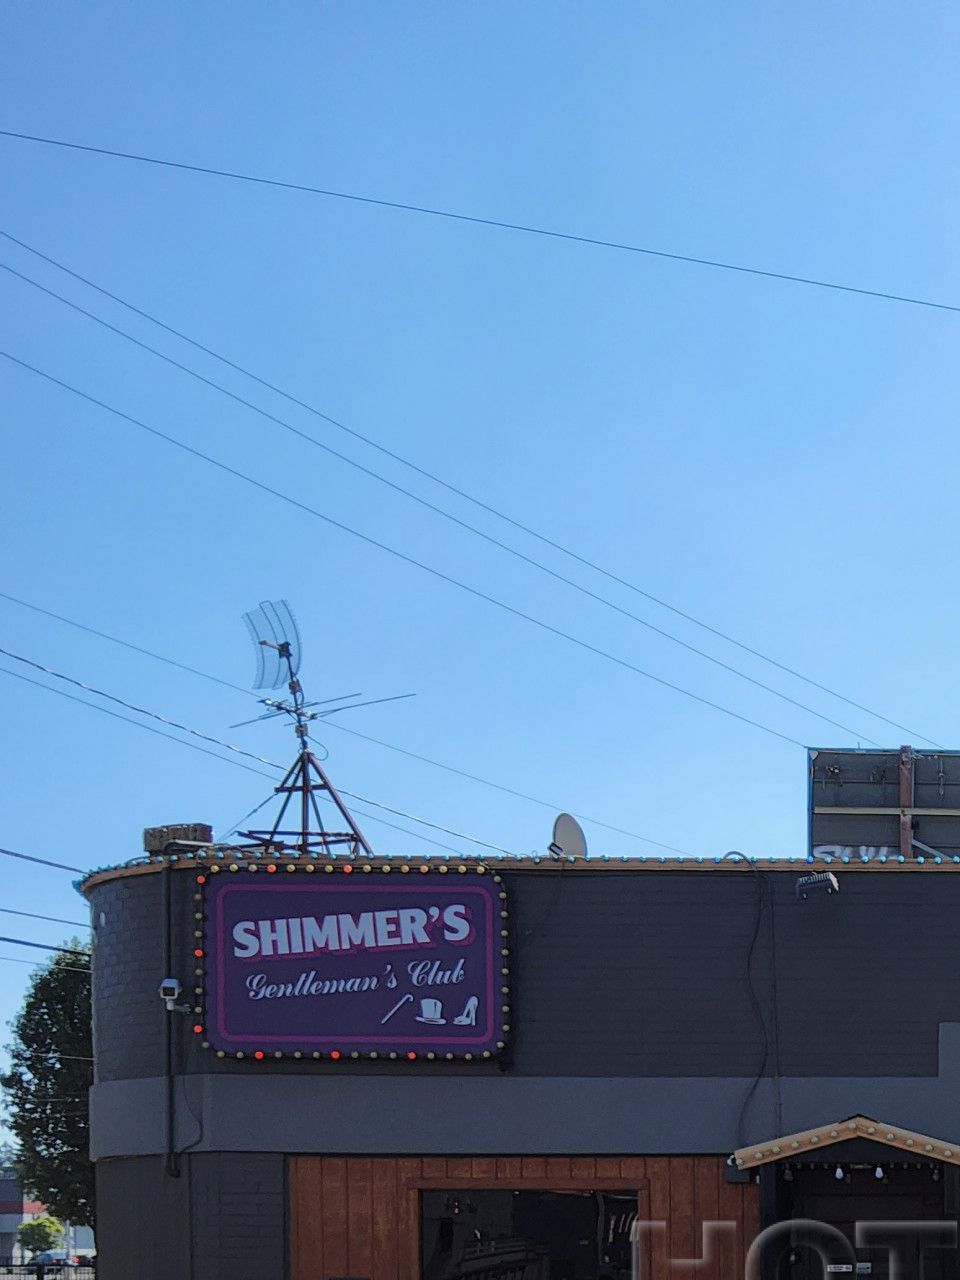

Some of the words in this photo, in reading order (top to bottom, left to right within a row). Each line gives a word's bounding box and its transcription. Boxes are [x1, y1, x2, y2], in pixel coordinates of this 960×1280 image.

[232, 904, 470, 958] SHIMMER'S
[245, 965, 399, 1000] Gentleman's
[407, 958, 466, 987] Club
